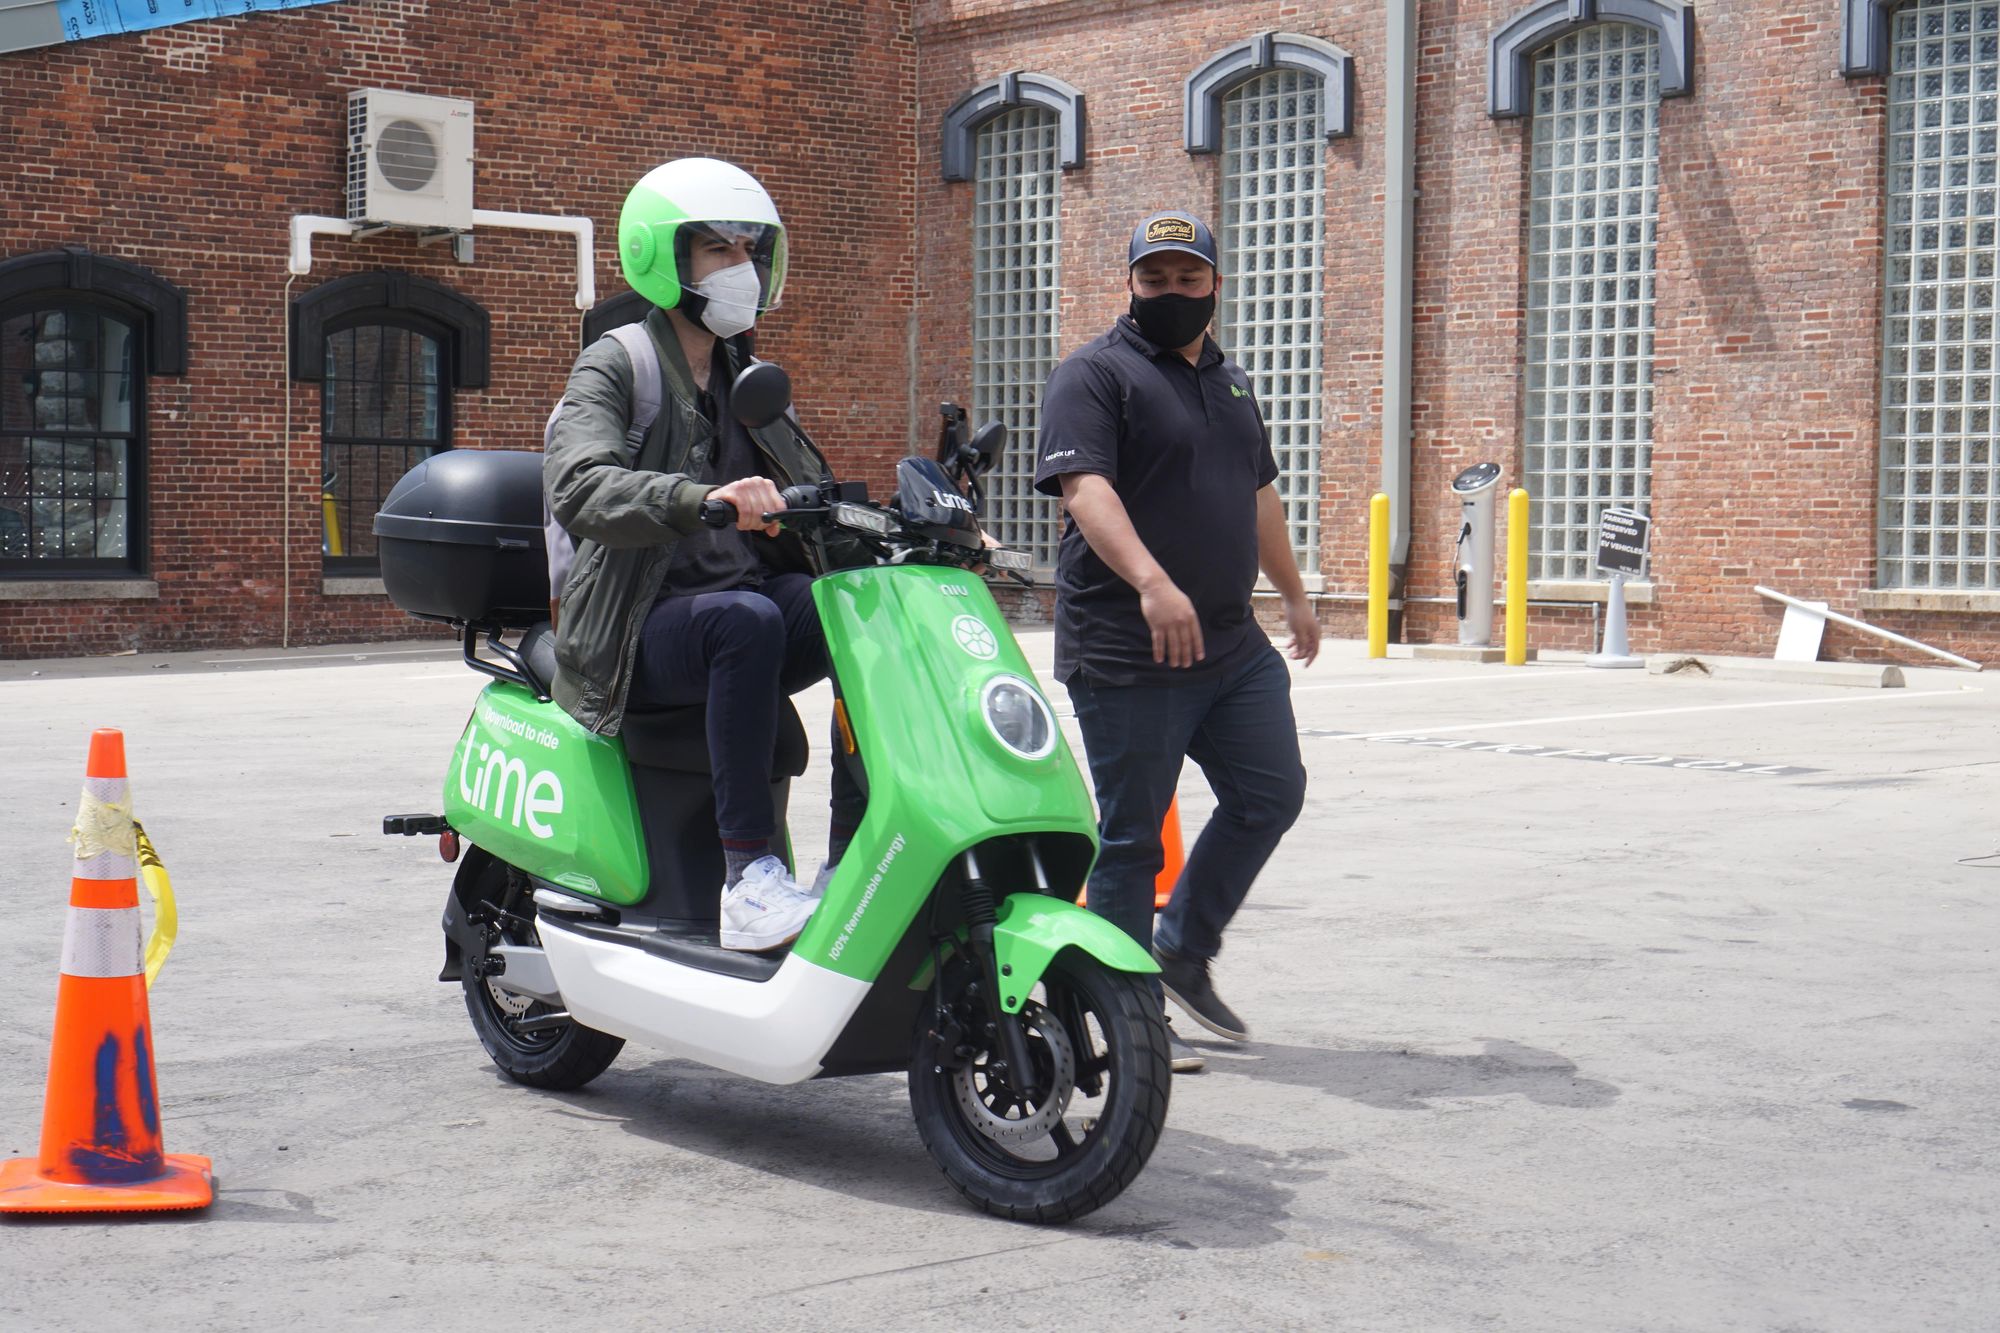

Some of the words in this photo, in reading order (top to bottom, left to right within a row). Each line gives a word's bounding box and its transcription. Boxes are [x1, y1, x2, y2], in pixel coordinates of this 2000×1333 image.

[1149, 224, 1192, 238] Imperial
[1604, 513, 1634, 526] PARKING
[1601, 531, 1616, 540] FOR
[1602, 522, 1638, 536] RESERVED
[1600, 540, 1610, 548] EV
[1610, 541, 1644, 555] VEHICLES
[525, 723, 537, 741] to
[536, 728, 560, 750] ride
[1366, 736, 1789, 775] CARPOOL
[828, 932, 850, 961] 100%
[843, 873, 883, 934] Renewable
[876, 832, 907, 874] Energy
